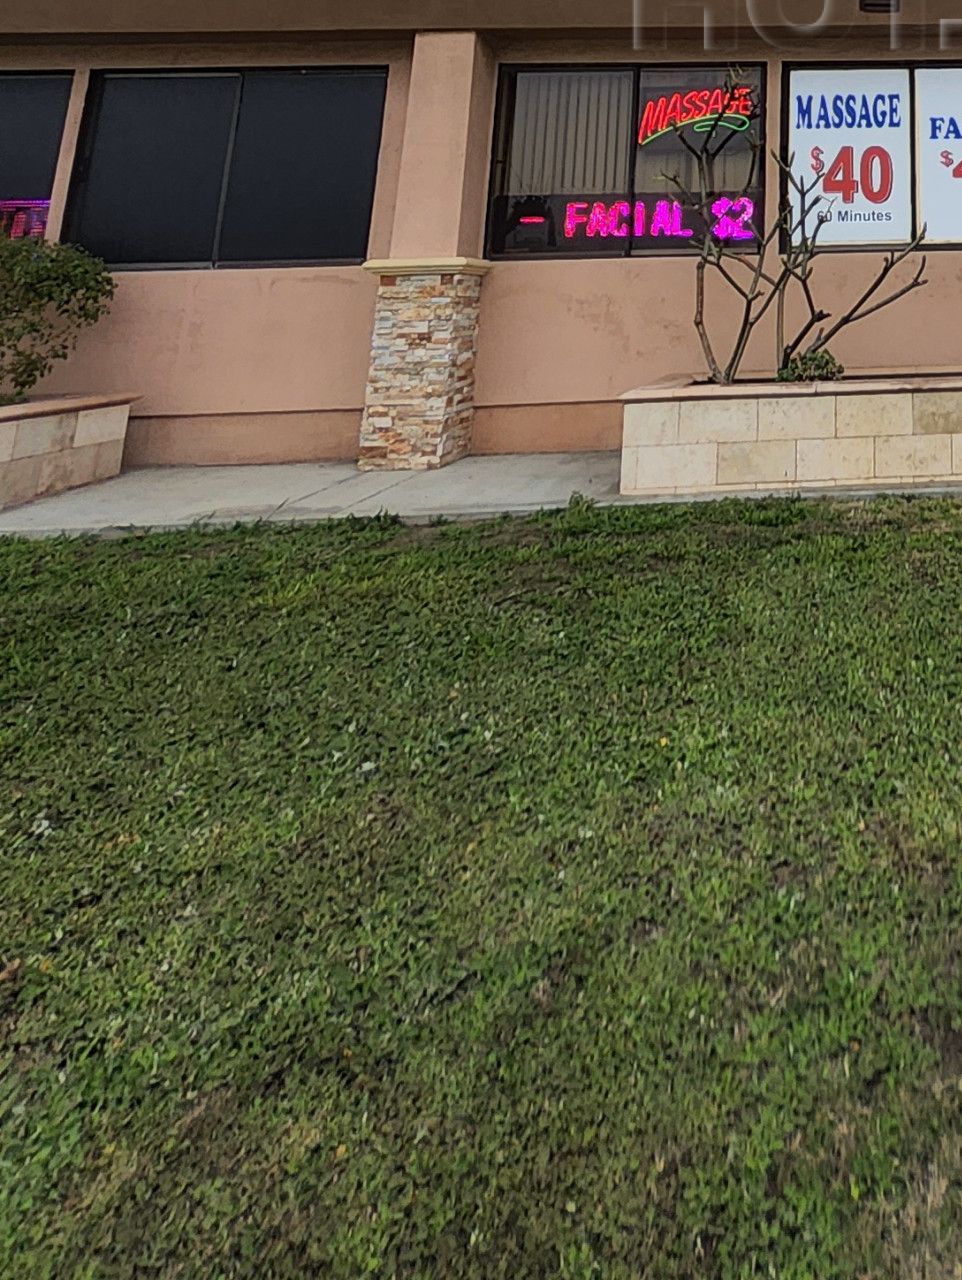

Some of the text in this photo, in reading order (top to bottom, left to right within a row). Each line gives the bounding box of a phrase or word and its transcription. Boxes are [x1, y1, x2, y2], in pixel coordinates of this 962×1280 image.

[795, 93, 902, 130] MASSAGE
[811, 145, 894, 204] $40
[563, 200, 694, 238] FACIAL
[838, 209, 892, 222] Minutes
